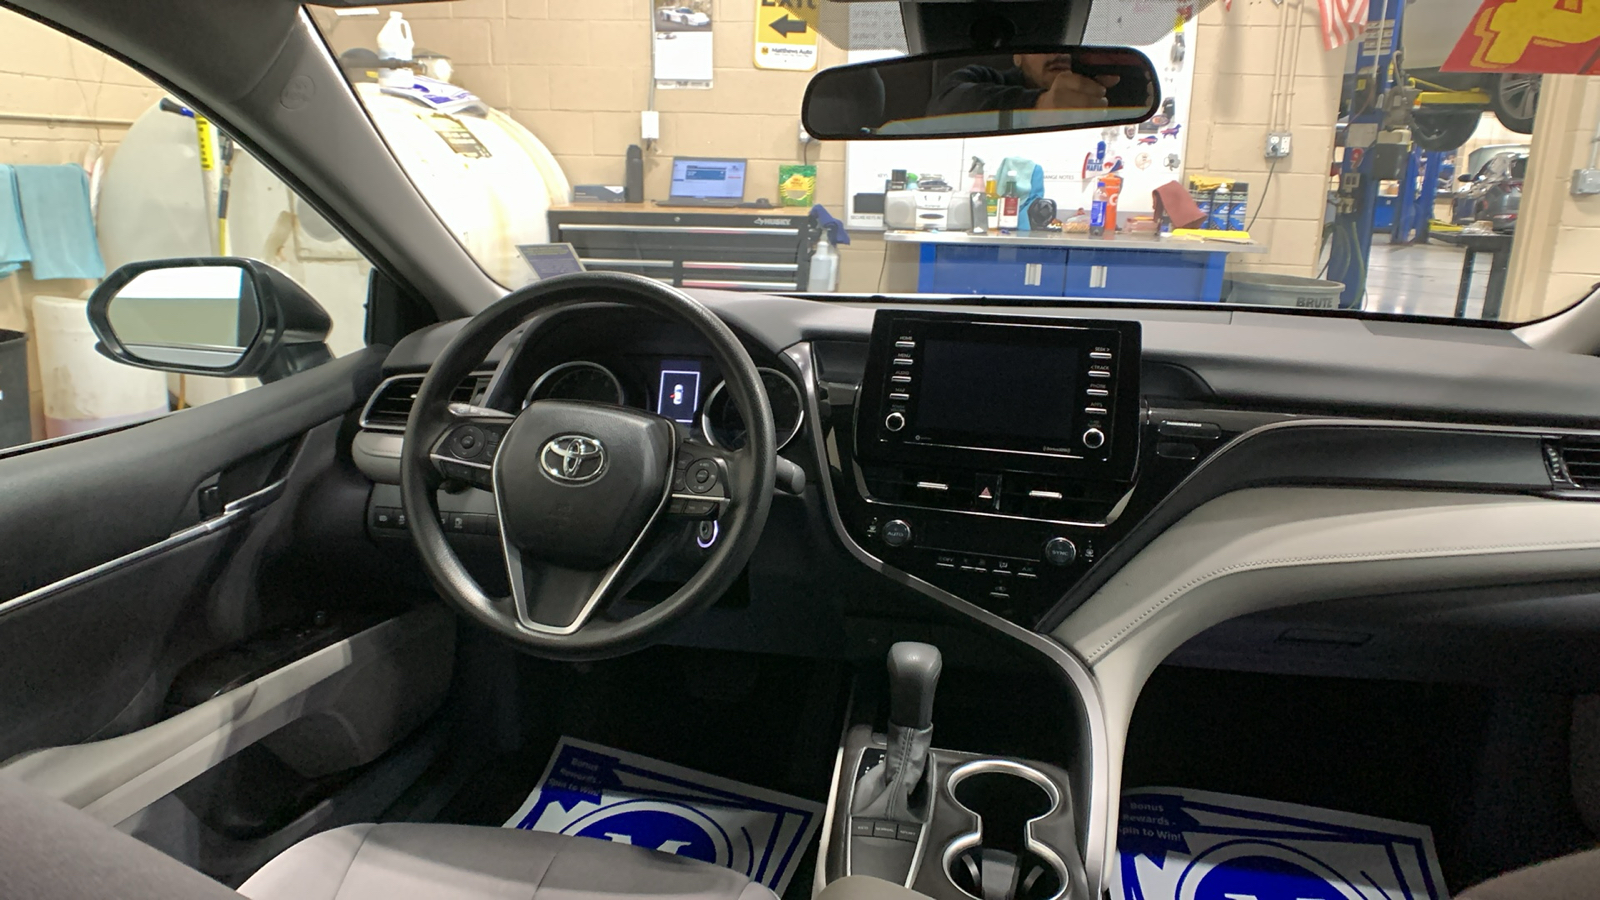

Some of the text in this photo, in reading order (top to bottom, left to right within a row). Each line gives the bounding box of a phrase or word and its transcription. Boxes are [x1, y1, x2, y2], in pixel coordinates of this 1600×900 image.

[1296, 297, 1333, 308] BRUTE
[1130, 802, 1164, 812] Bonus
[1122, 813, 1170, 826] Rewards
[1142, 828, 1154, 837] to
[1156, 829, 1181, 842] Win!
